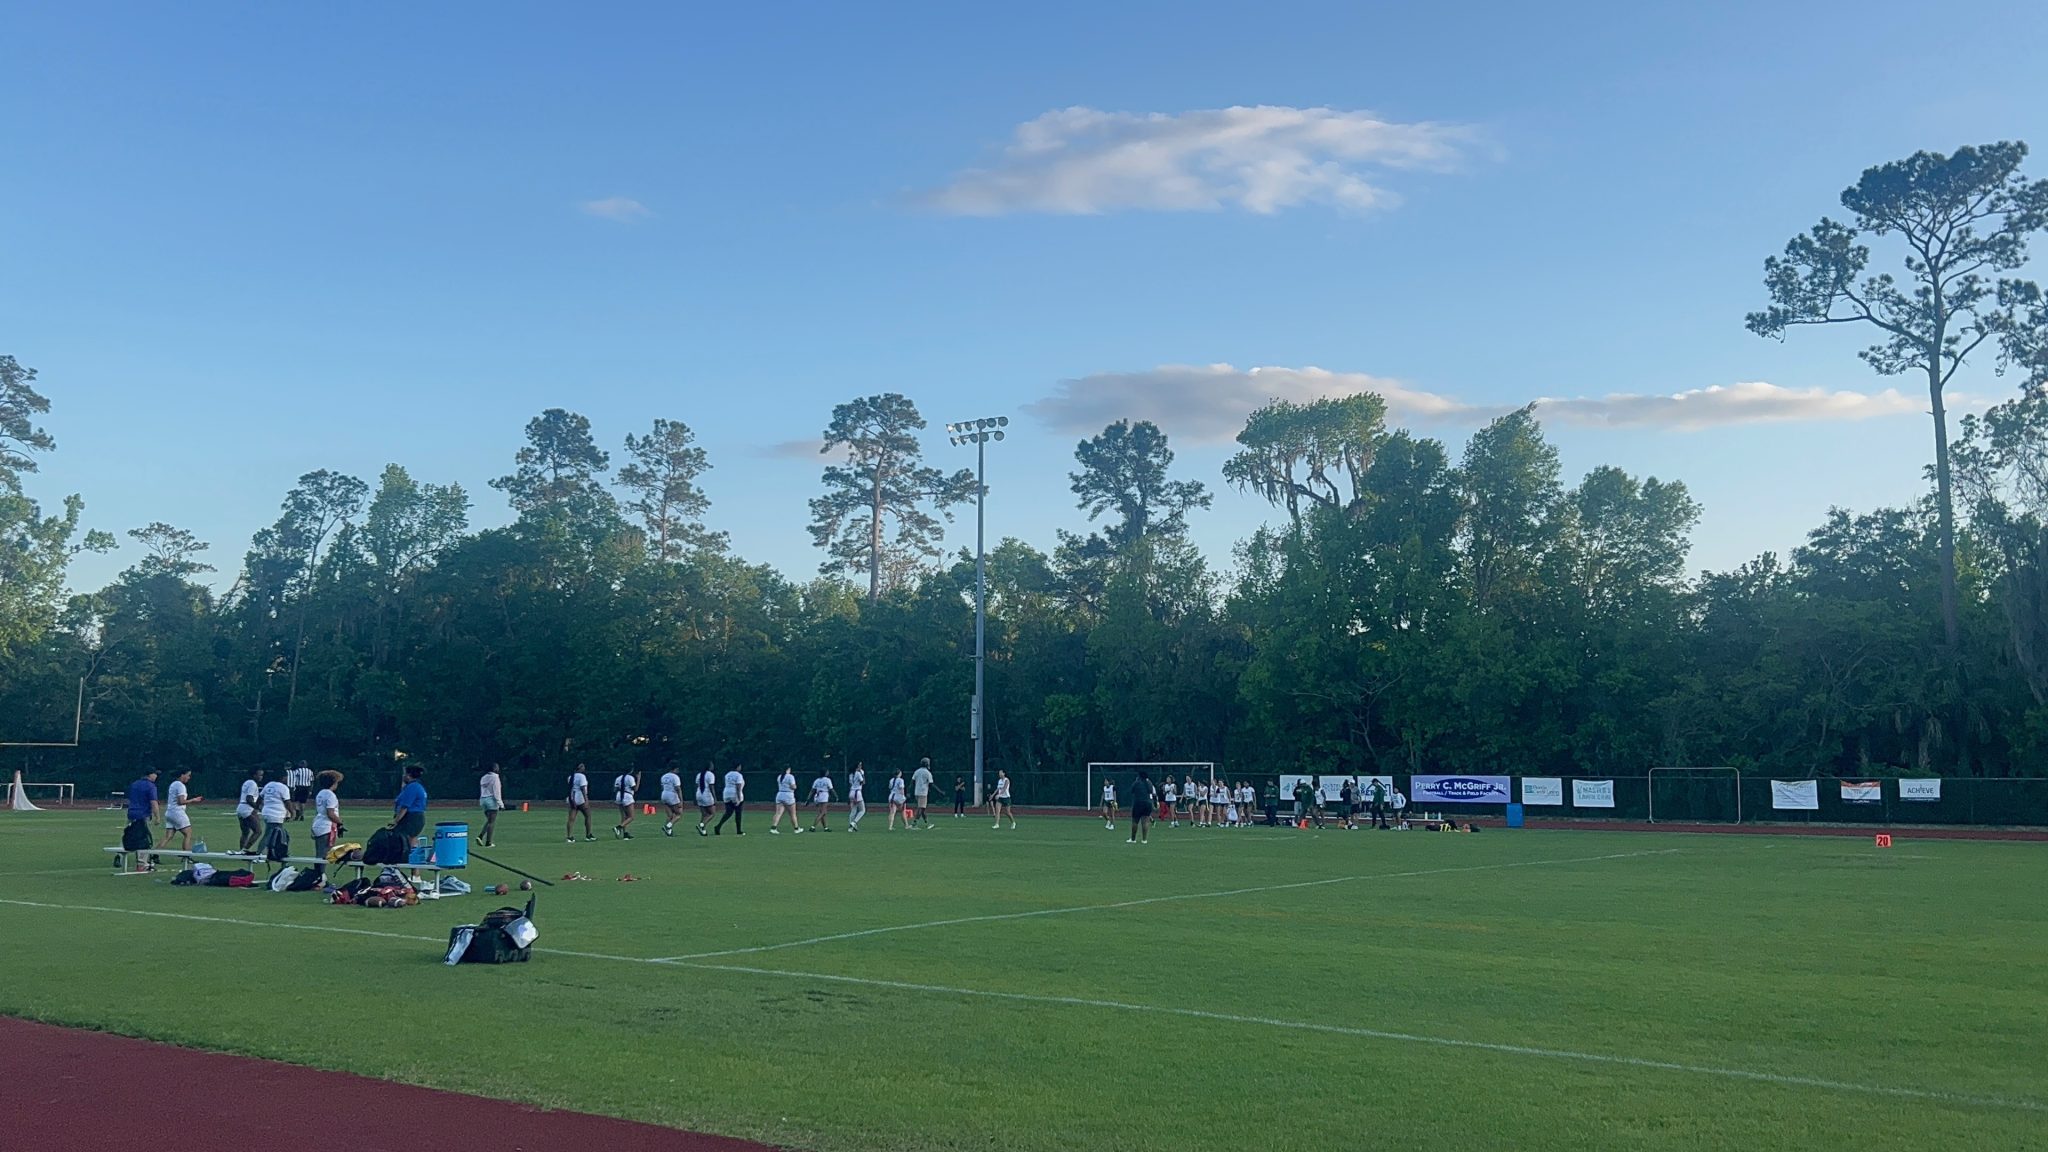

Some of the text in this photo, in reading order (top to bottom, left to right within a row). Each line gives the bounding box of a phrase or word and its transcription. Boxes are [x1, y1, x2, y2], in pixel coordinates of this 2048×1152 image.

[1415, 782, 1440, 790] PERRY
[1443, 782, 1452, 790] C.
[1907, 786, 1934, 794] ACHIEVE
[1877, 836, 1889, 847] 20
